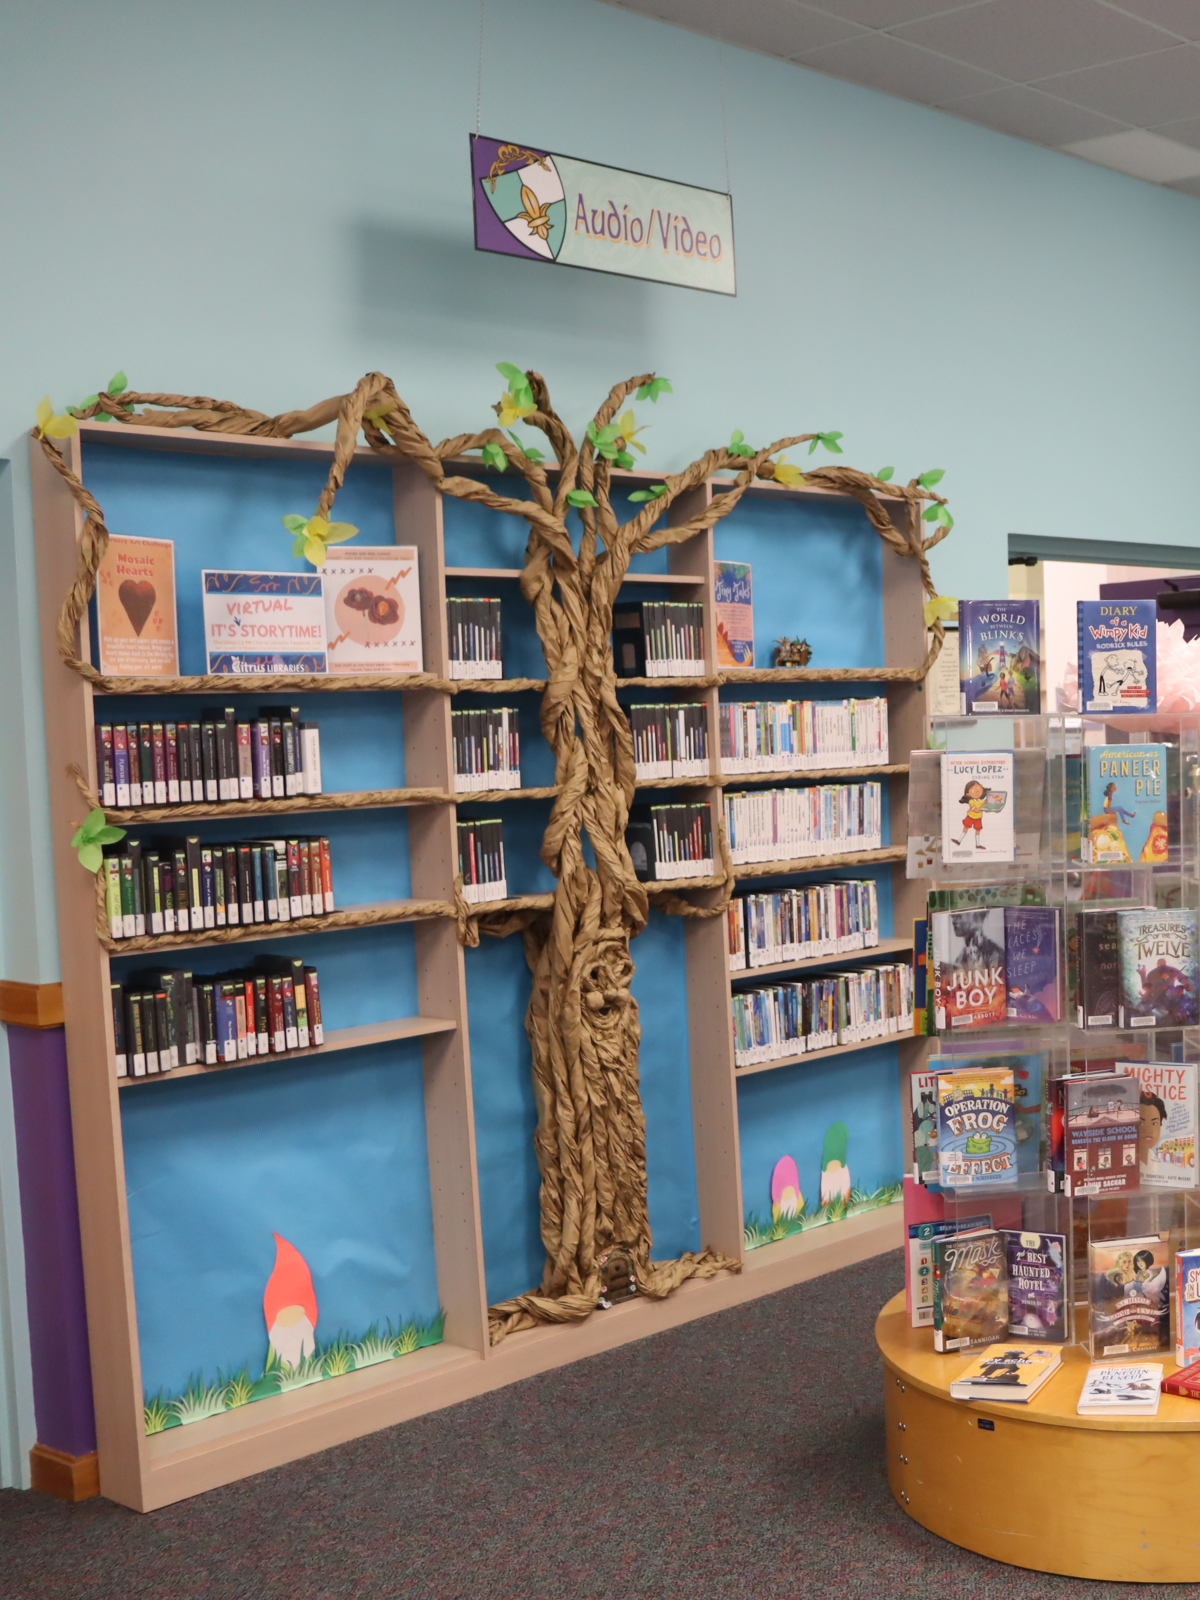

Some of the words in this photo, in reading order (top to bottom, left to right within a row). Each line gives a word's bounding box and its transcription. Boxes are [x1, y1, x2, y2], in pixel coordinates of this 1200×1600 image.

[117, 553, 155, 565] Mosaic
[116, 565, 154, 577] Hearts
[715, 579, 732, 603] Tiny
[733, 580, 751, 602] Tales
[226, 598, 293, 615] VIRTUAL
[1099, 606, 1138, 616] DIARY
[978, 613, 1026, 625] WORLD
[1110, 617, 1119, 626] of
[211, 623, 237, 638] IT'S
[240, 624, 322, 638] STORYTIME!
[980, 630, 1024, 641] BLINKS
[1088, 624, 1128, 642] Wimpy
[1128, 623, 1148, 639] Kid
[267, 663, 305, 673] LIBRARIES
[1099, 750, 1145, 759] American
[953, 765, 974, 774] LUCY
[976, 765, 1002, 774] LOPEZ
[1100, 759, 1161, 778] PANEER
[1135, 779, 1161, 796] PIE
[1007, 920, 1027, 933] THE
[1138, 923, 1187, 936] TREASURES
[1007, 930, 1038, 948] LACES
[1098, 943, 1117, 951] sea
[1133, 940, 1191, 960] TWELVE
[1012, 949, 1027, 961] WE
[1006, 961, 1037, 978] SLEEP
[946, 966, 1004, 992] JUNK
[955, 986, 998, 1009] BOY
[974, 1011, 995, 1020] ABBOTT
[1123, 1066, 1186, 1084] MIGHTY
[918, 1076, 935, 1088] LIT
[1140, 1083, 1187, 1100] STICE
[944, 1099, 1011, 1117] OPERATION
[946, 1111, 1009, 1136] FROG
[1071, 1128, 1105, 1138] WAYSIDE
[1106, 1125, 1138, 1135] SCHOOL
[946, 1153, 1014, 1176] EFFECT
[1103, 1178, 1126, 1187] SACHAR
[924, 1227, 930, 1236] 2
[961, 1221, 984, 1229] READING
[1027, 1252, 1048, 1264] BEST
[1012, 1264, 1050, 1278] HAUNTED
[1018, 1278, 1045, 1291] HOTEL
[1187, 1284, 1195, 1292] IN
[1186, 1291, 1196, 1299] THE
[1190, 1389, 1200, 1398] THE
